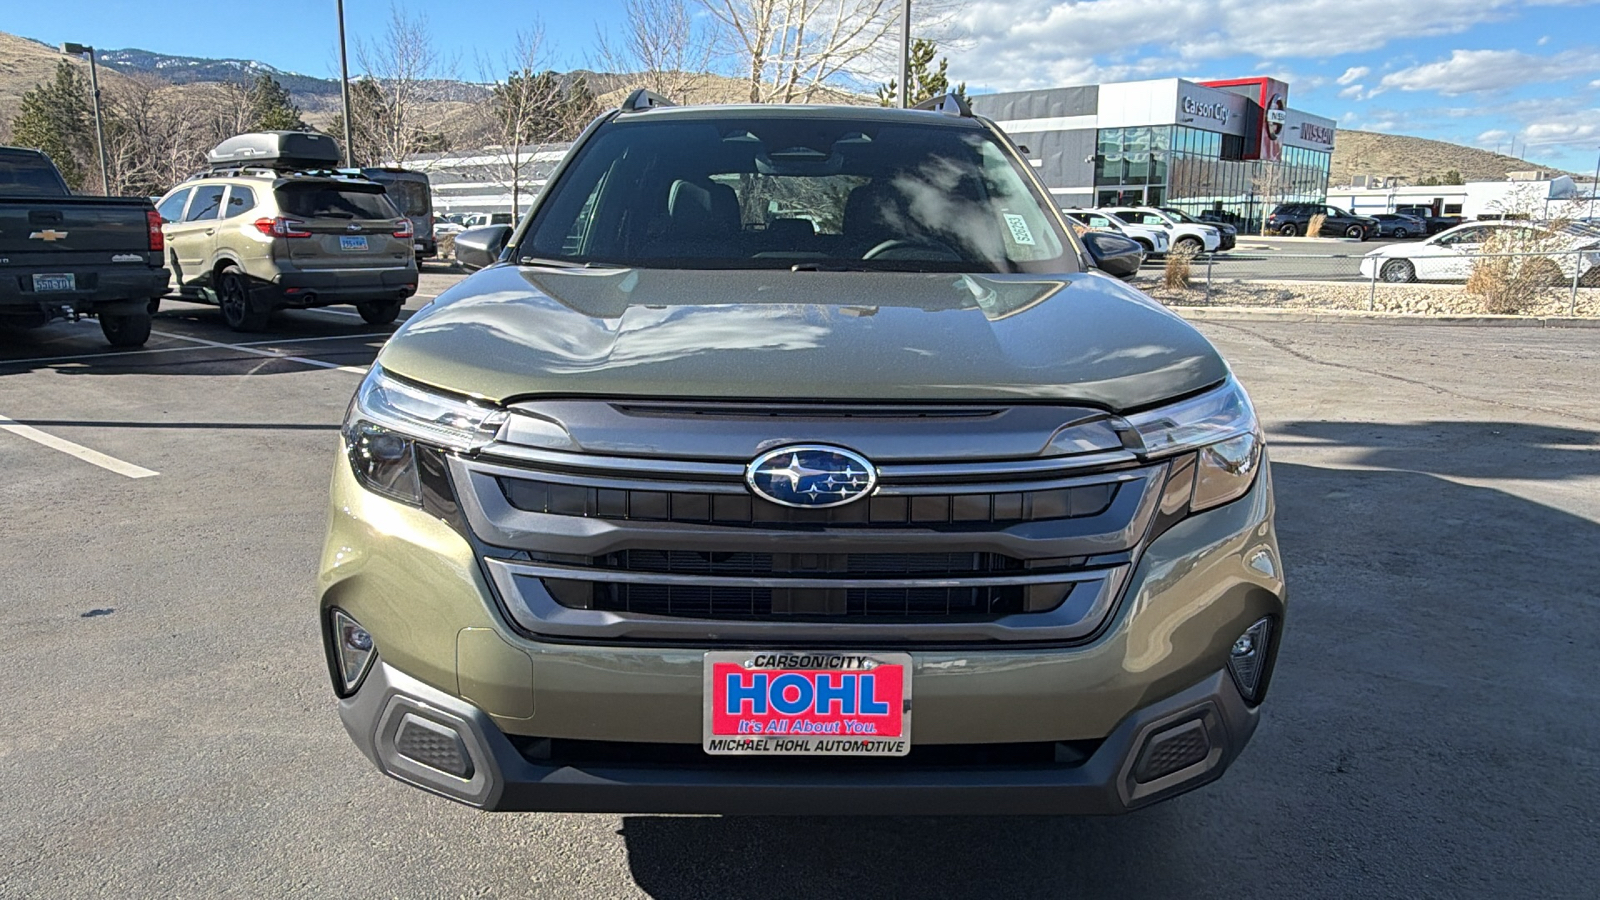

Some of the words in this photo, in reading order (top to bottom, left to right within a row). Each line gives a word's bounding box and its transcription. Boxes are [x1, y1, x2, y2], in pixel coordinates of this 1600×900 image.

[1184, 96, 1215, 118] Carson
[1215, 103, 1231, 125] City
[1300, 122, 1334, 145] NISSAN
[754, 655, 824, 668] CARSON
[828, 656, 867, 668] CITY
[726, 673, 889, 716] HOHL
[738, 720, 762, 733] It's
[766, 720, 788, 733] All
[791, 720, 840, 733] About
[844, 720, 878, 734] You.
[708, 739, 770, 751] MICHAEL
[775, 740, 811, 752] HOHL
[814, 740, 905, 753] AUTOMOTIVE
